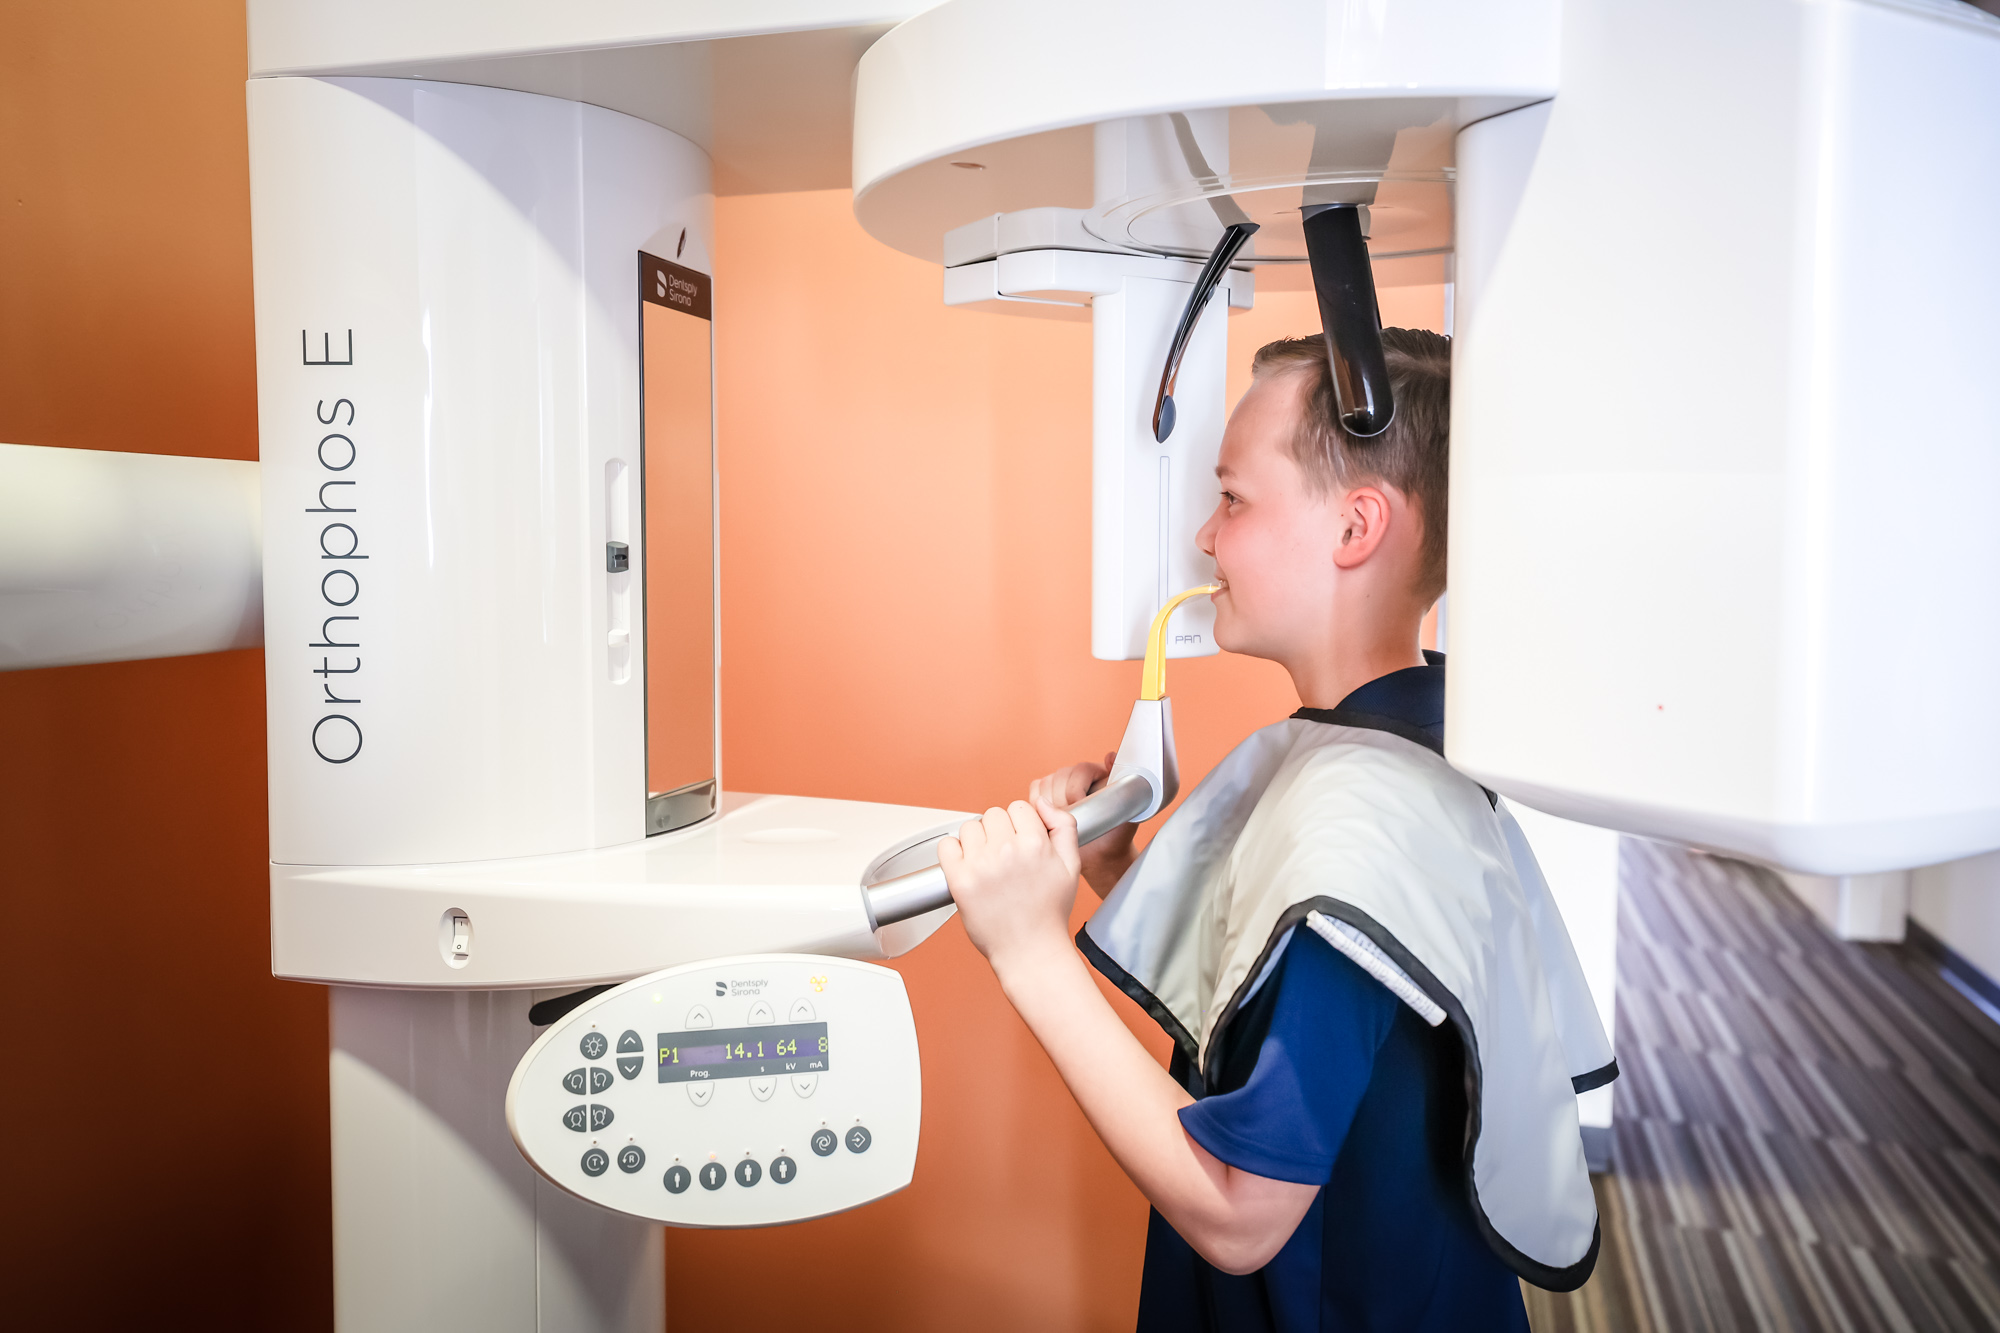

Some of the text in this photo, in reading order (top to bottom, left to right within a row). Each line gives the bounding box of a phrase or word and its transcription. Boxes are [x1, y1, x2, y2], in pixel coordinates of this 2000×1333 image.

[669, 274, 698, 297] Dentsply
[669, 288, 692, 307] Sirona
[302, 328, 369, 764] Orthophos E
[1175, 634, 1202, 644] PAN
[731, 979, 769, 988] Dentsply
[731, 988, 761, 997] Sirona
[659, 1036, 828, 1064] P1 14.1 64 8
[690, 1069, 711, 1079] Prog.
[785, 1062, 797, 1071] kV
[809, 1060, 823, 1069] mA
